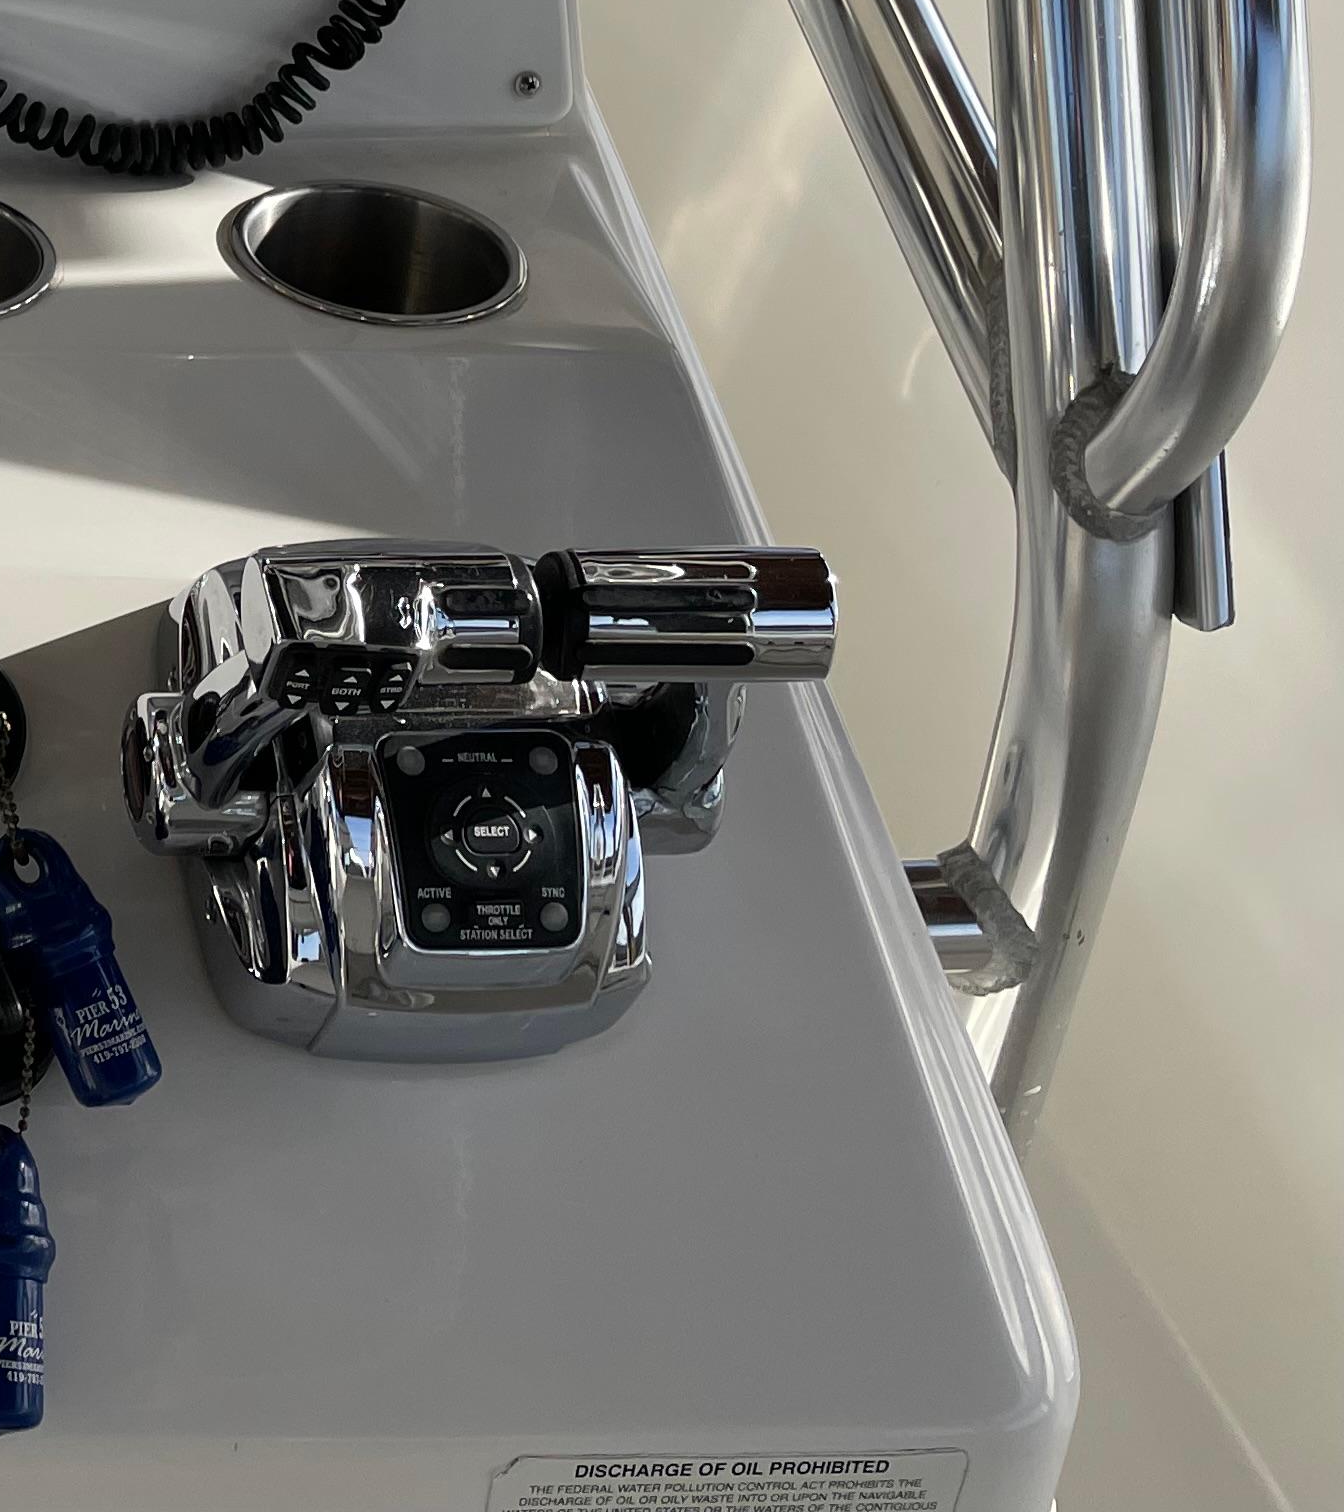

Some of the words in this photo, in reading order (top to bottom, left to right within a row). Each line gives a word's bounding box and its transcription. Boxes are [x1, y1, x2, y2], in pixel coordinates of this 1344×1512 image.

[331, 688, 362, 696] BOTH
[458, 753, 498, 763] NEUTRAL
[474, 826, 509, 837] SELECT
[417, 887, 451, 899] ACTIVE
[541, 888, 565, 898] SYNC
[476, 904, 520, 916] THROTTLE
[488, 916, 509, 925] ONLY
[460, 929, 498, 940] STATION
[499, 929, 533, 939] SELECT
[75, 1000, 111, 1024] PIER
[106, 984, 127, 1010] 53
[9, 1319, 38, 1339] PIER
[575, 1463, 694, 1478] DISCHARGE
[698, 1462, 728, 1477] OF
[731, 1461, 763, 1476] OIL
[769, 1459, 890, 1475] PROHIBITED
[529, 1485, 553, 1494] THE
[557, 1484, 613, 1494] FEDERAL
[618, 1483, 661, 1493] WATER
[664, 1482, 734, 1493] POLLUTION
[738, 1481, 796, 1491] CONTROL
[800, 1480, 825, 1490] ACT
[828, 1479, 894, 1489] PROHIBITS
[898, 1478, 922, 1488] THE
[519, 1496, 591, 1507] DISCHARGE
[595, 1496, 614, 1506] OF
[616, 1495, 634, 1506] OIL
[639, 1495, 657, 1505] OR
[660, 1494, 688, 1505] OILY
[691, 1493, 734, 1504] WASTE
[737, 1493, 768, 1503] INTO
[770, 1493, 789, 1503] OR
[792, 1492, 828, 1502] UPON
[832, 1491, 854, 1501] THE
[858, 1490, 928, 1500] NAVIGABLE
[829, 1503, 852, 1512] THE
